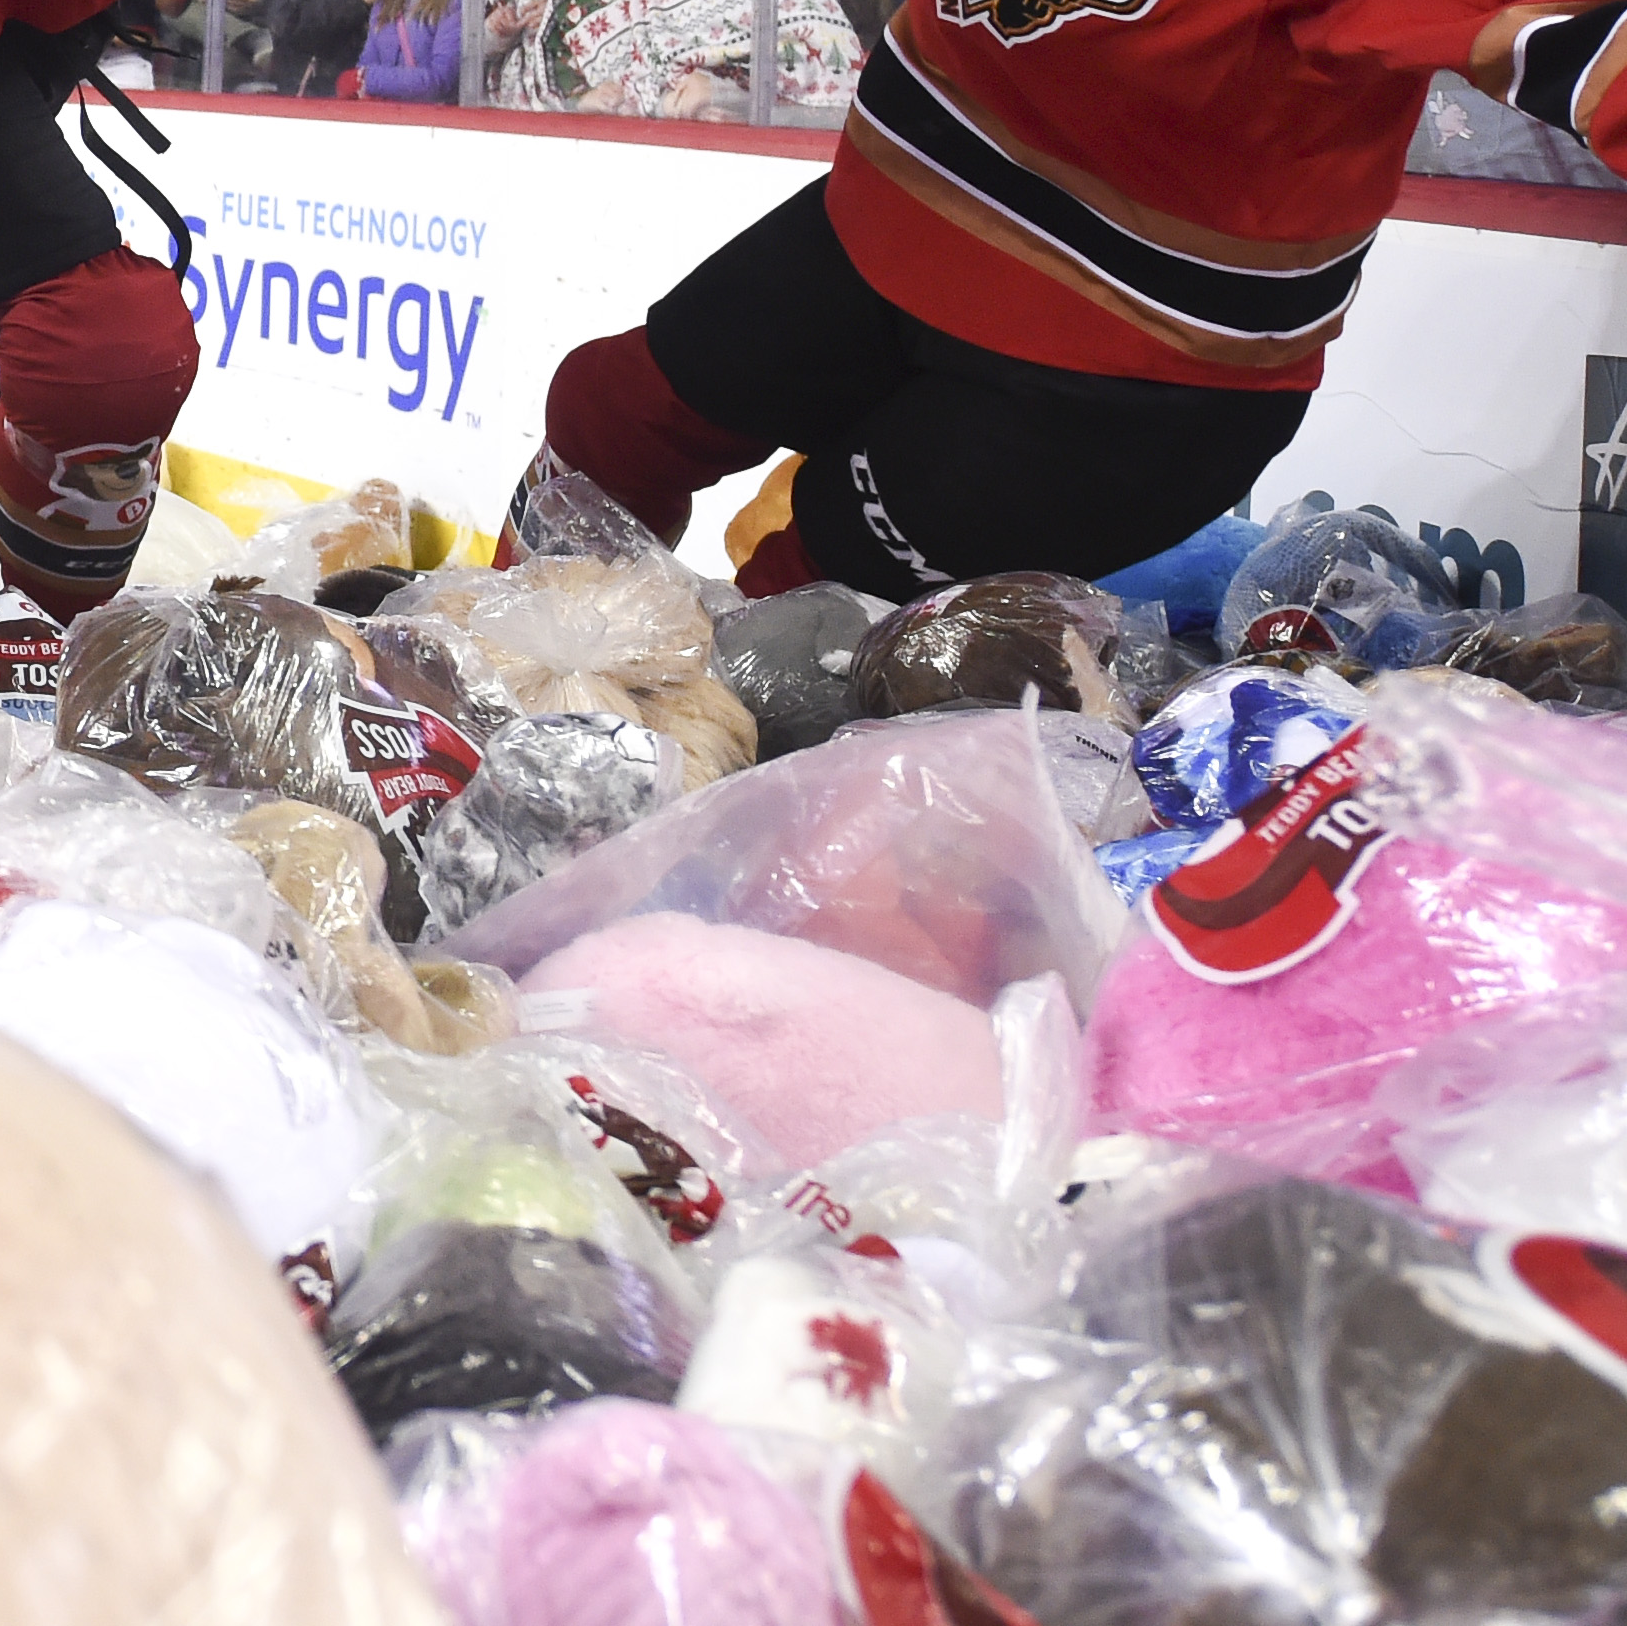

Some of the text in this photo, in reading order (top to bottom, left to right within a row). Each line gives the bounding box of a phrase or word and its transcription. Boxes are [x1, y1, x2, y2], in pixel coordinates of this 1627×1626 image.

[221, 191, 487, 260] FUEL TECHNOLOGY
[167, 214, 485, 422] Synergy
[350, 718, 427, 760] TOSS
[376, 774, 422, 800] BEAR
[1258, 782, 1321, 846] TEDDY
